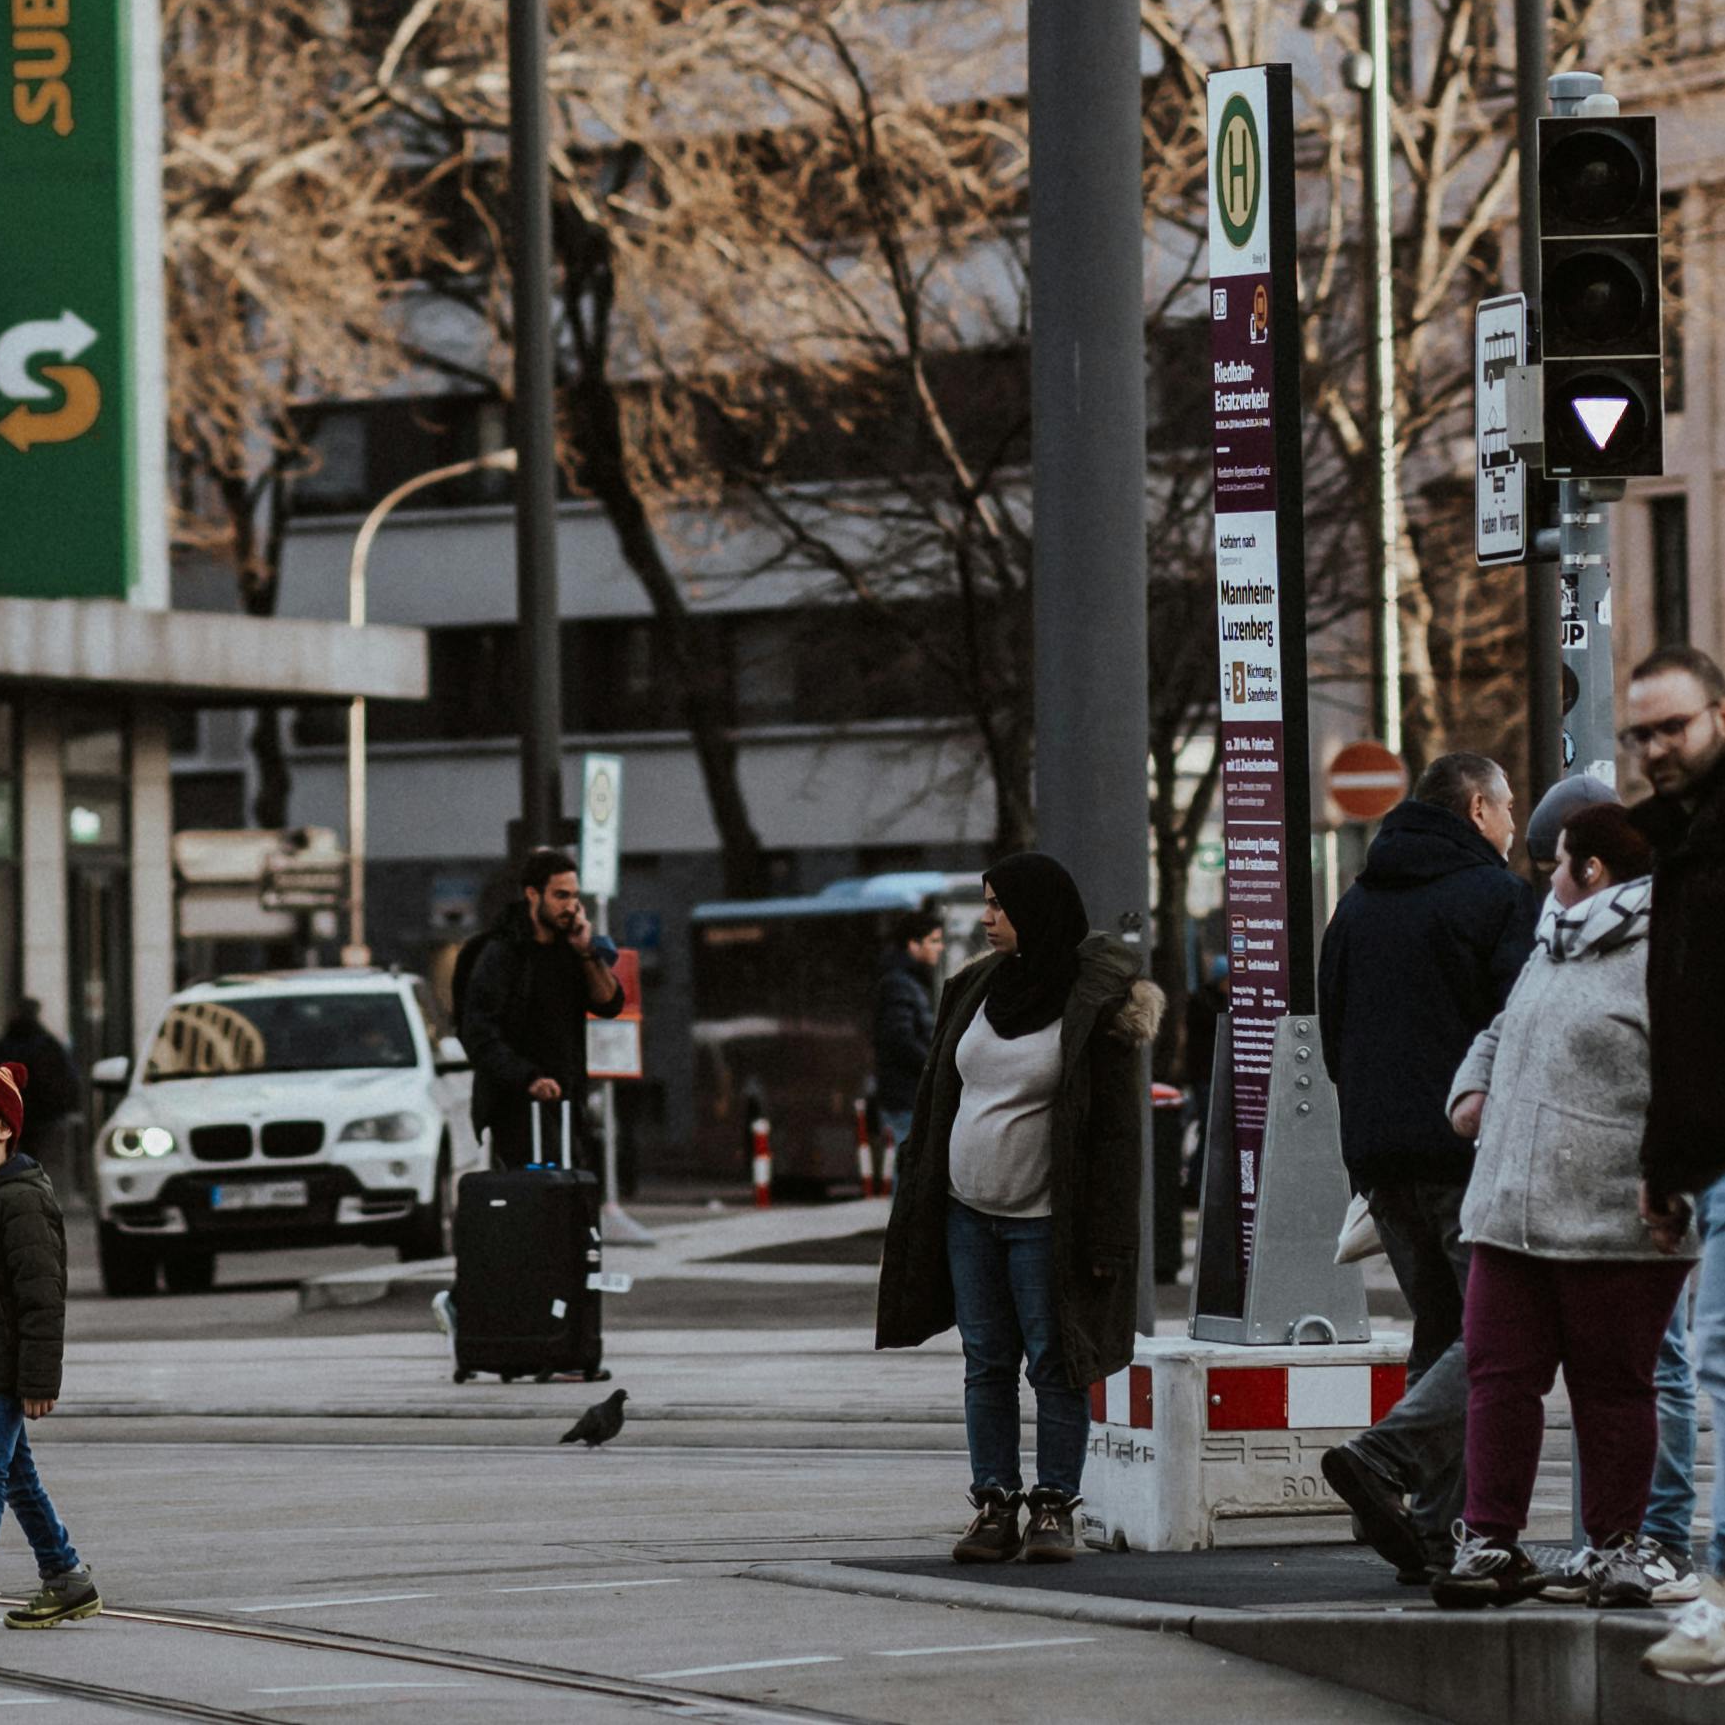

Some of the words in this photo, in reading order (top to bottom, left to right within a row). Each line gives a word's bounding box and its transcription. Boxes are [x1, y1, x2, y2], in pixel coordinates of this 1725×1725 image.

[1215, 294, 1225, 316] DB
[1214, 360, 1255, 383] Riedbahn-
[1214, 387, 1270, 412] Ersatzverkehr
[1220, 534, 1242, 549] Abfahrt
[1221, 577, 1275, 605] Mannheim-
[1222, 615, 1274, 647] Luzenberg
[1236, 671, 1243, 696] 3
[1247, 663, 1272, 682] Richtung
